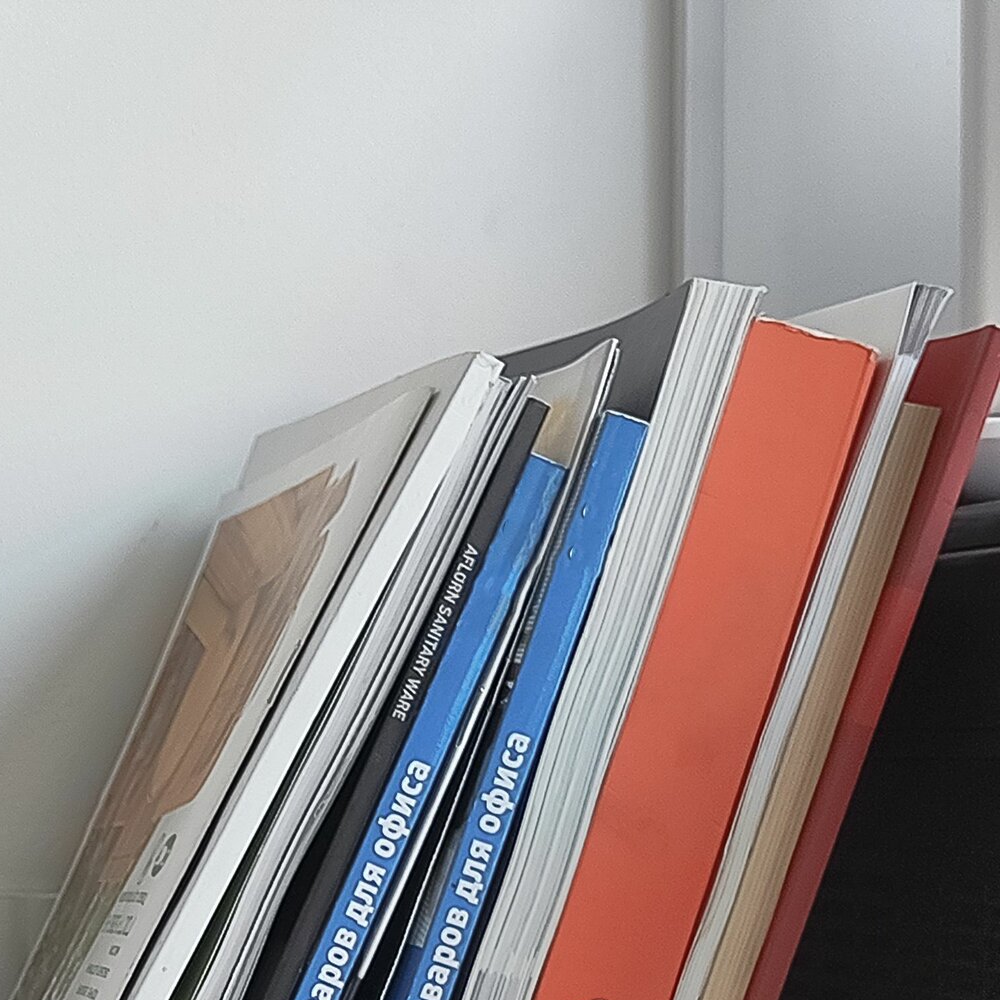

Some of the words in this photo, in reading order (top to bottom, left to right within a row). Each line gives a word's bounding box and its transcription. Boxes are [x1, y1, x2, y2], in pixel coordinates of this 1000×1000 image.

[392, 676, 421, 722] WARE
[412, 604, 453, 677] SANITARY
[345, 862, 387, 928] для
[373, 760, 432, 859] офиса
[455, 838, 494, 906] для
[479, 732, 532, 835] офиса
